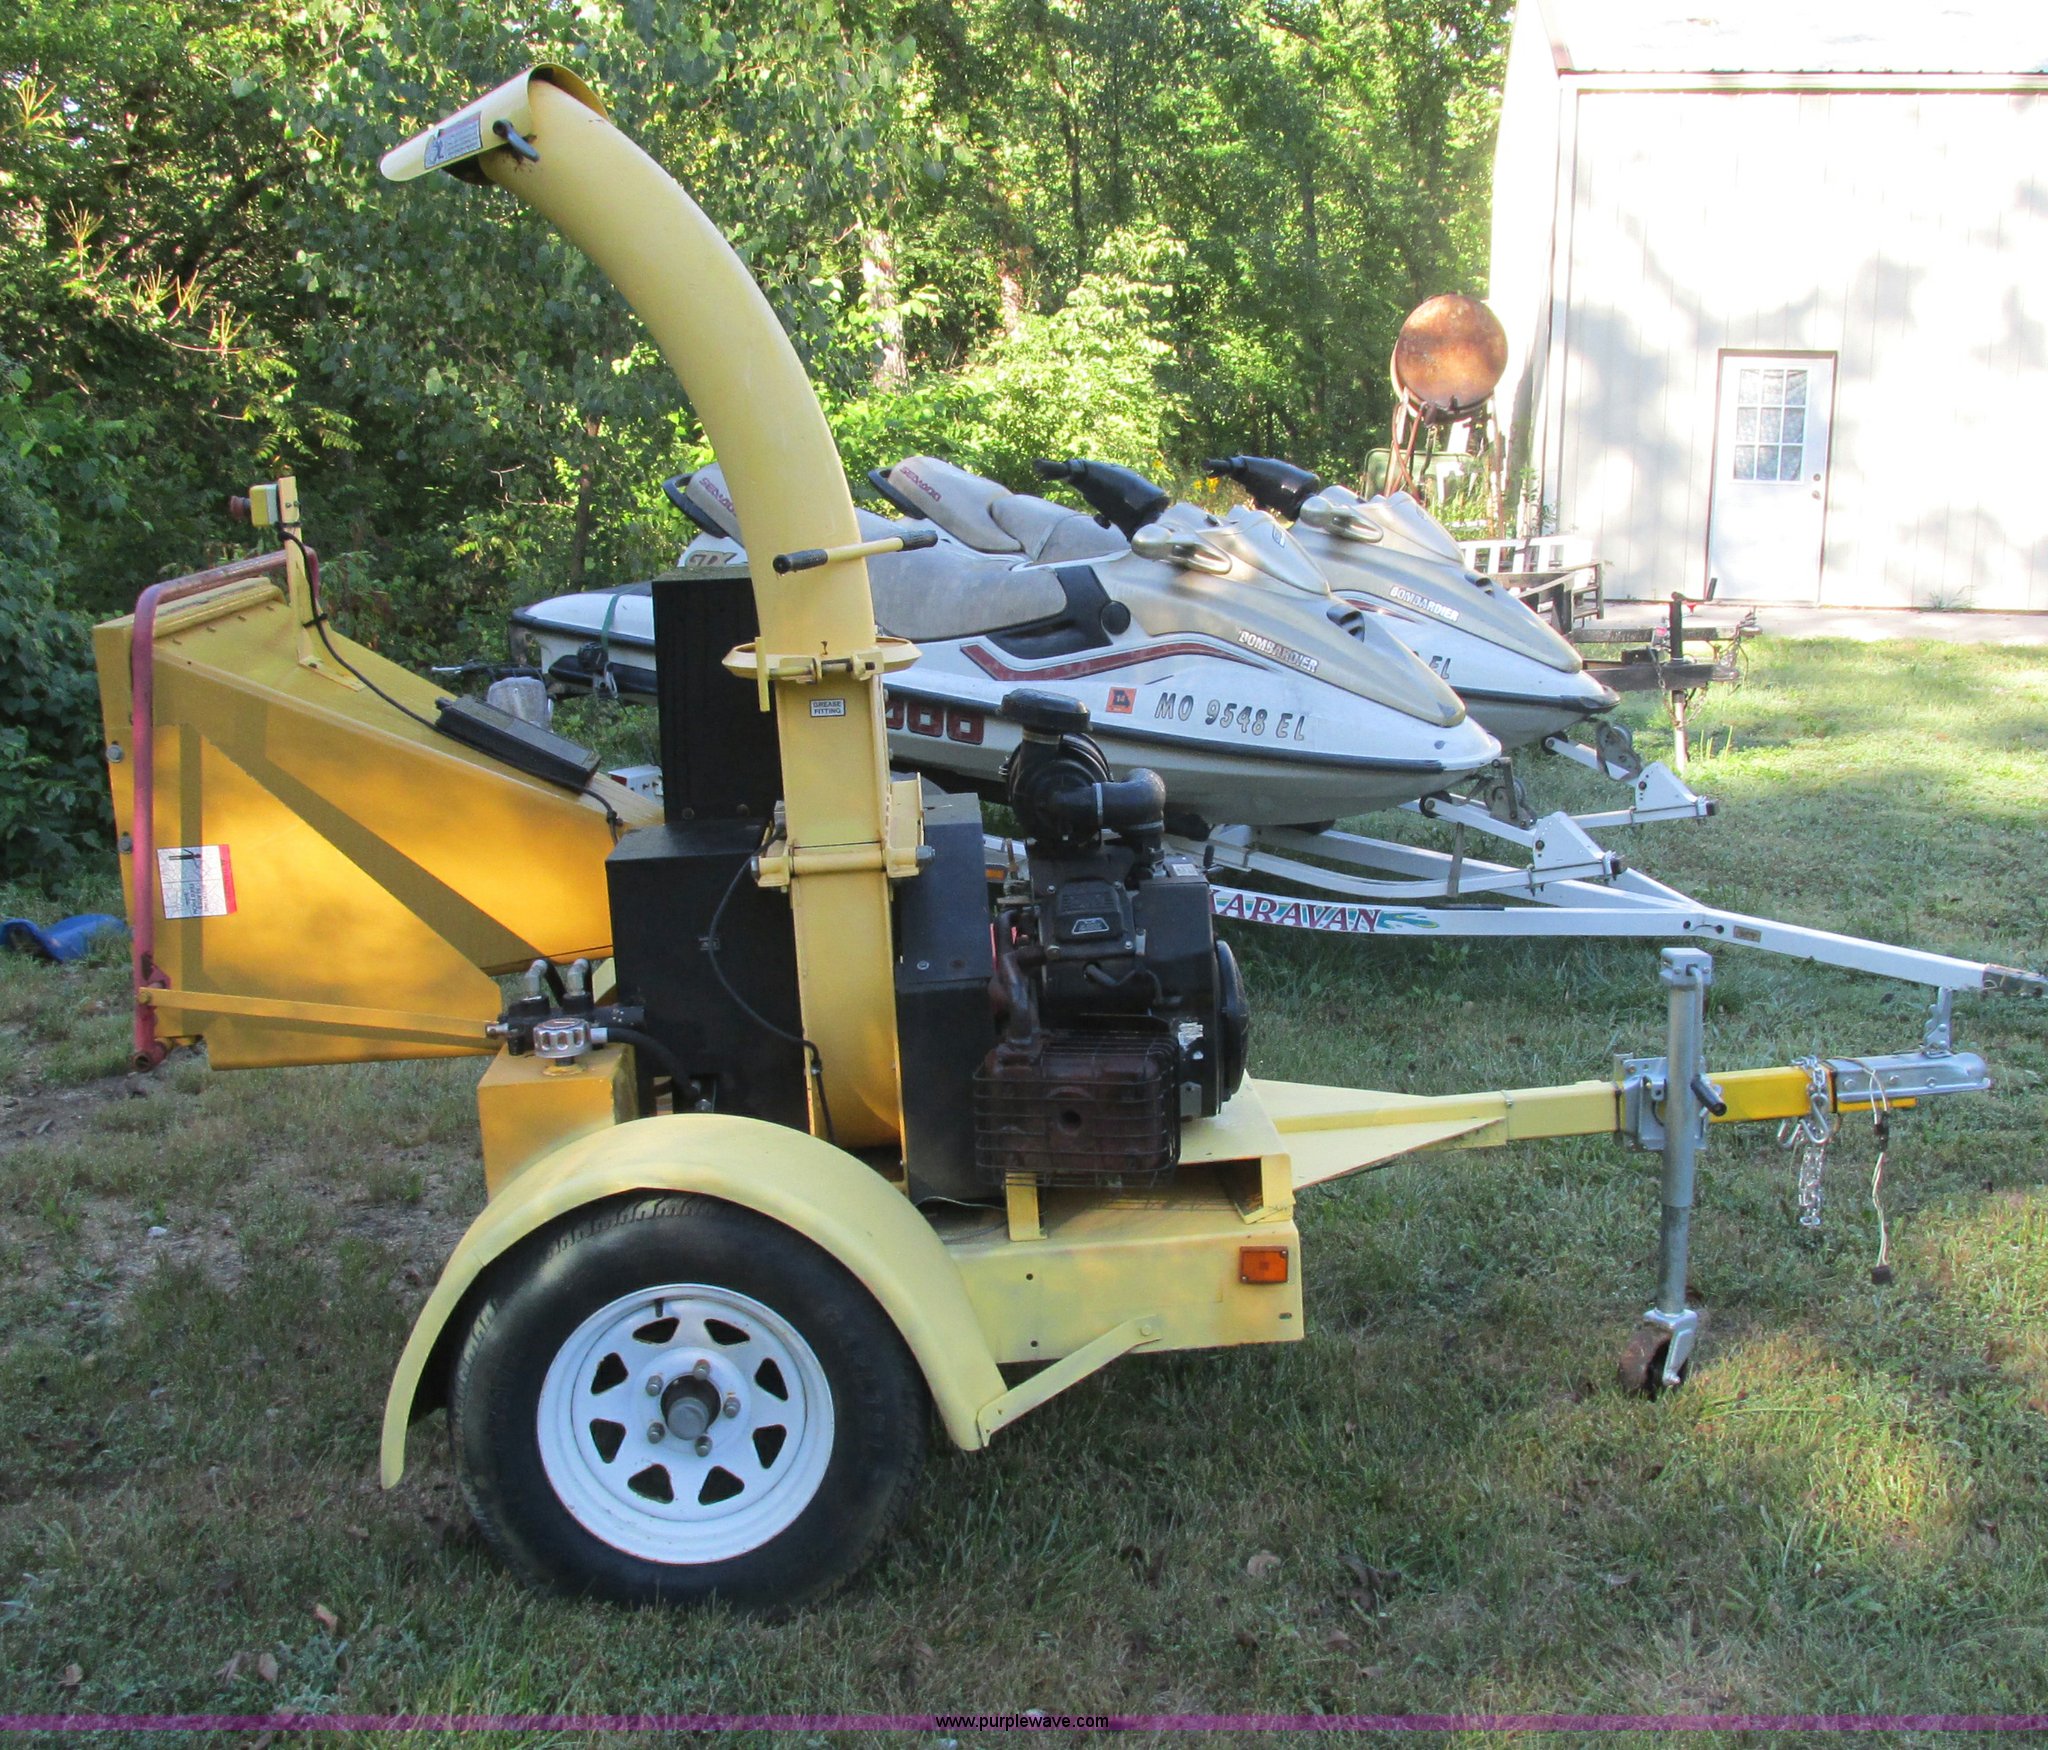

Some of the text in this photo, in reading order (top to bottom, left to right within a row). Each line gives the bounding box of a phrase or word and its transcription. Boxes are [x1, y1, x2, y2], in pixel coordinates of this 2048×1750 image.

[1389, 585, 1460, 622] BOMBARDIER
[1238, 630, 1319, 673] BOMBARDIER
[1155, 692, 1306, 741] MO 9548 EL
